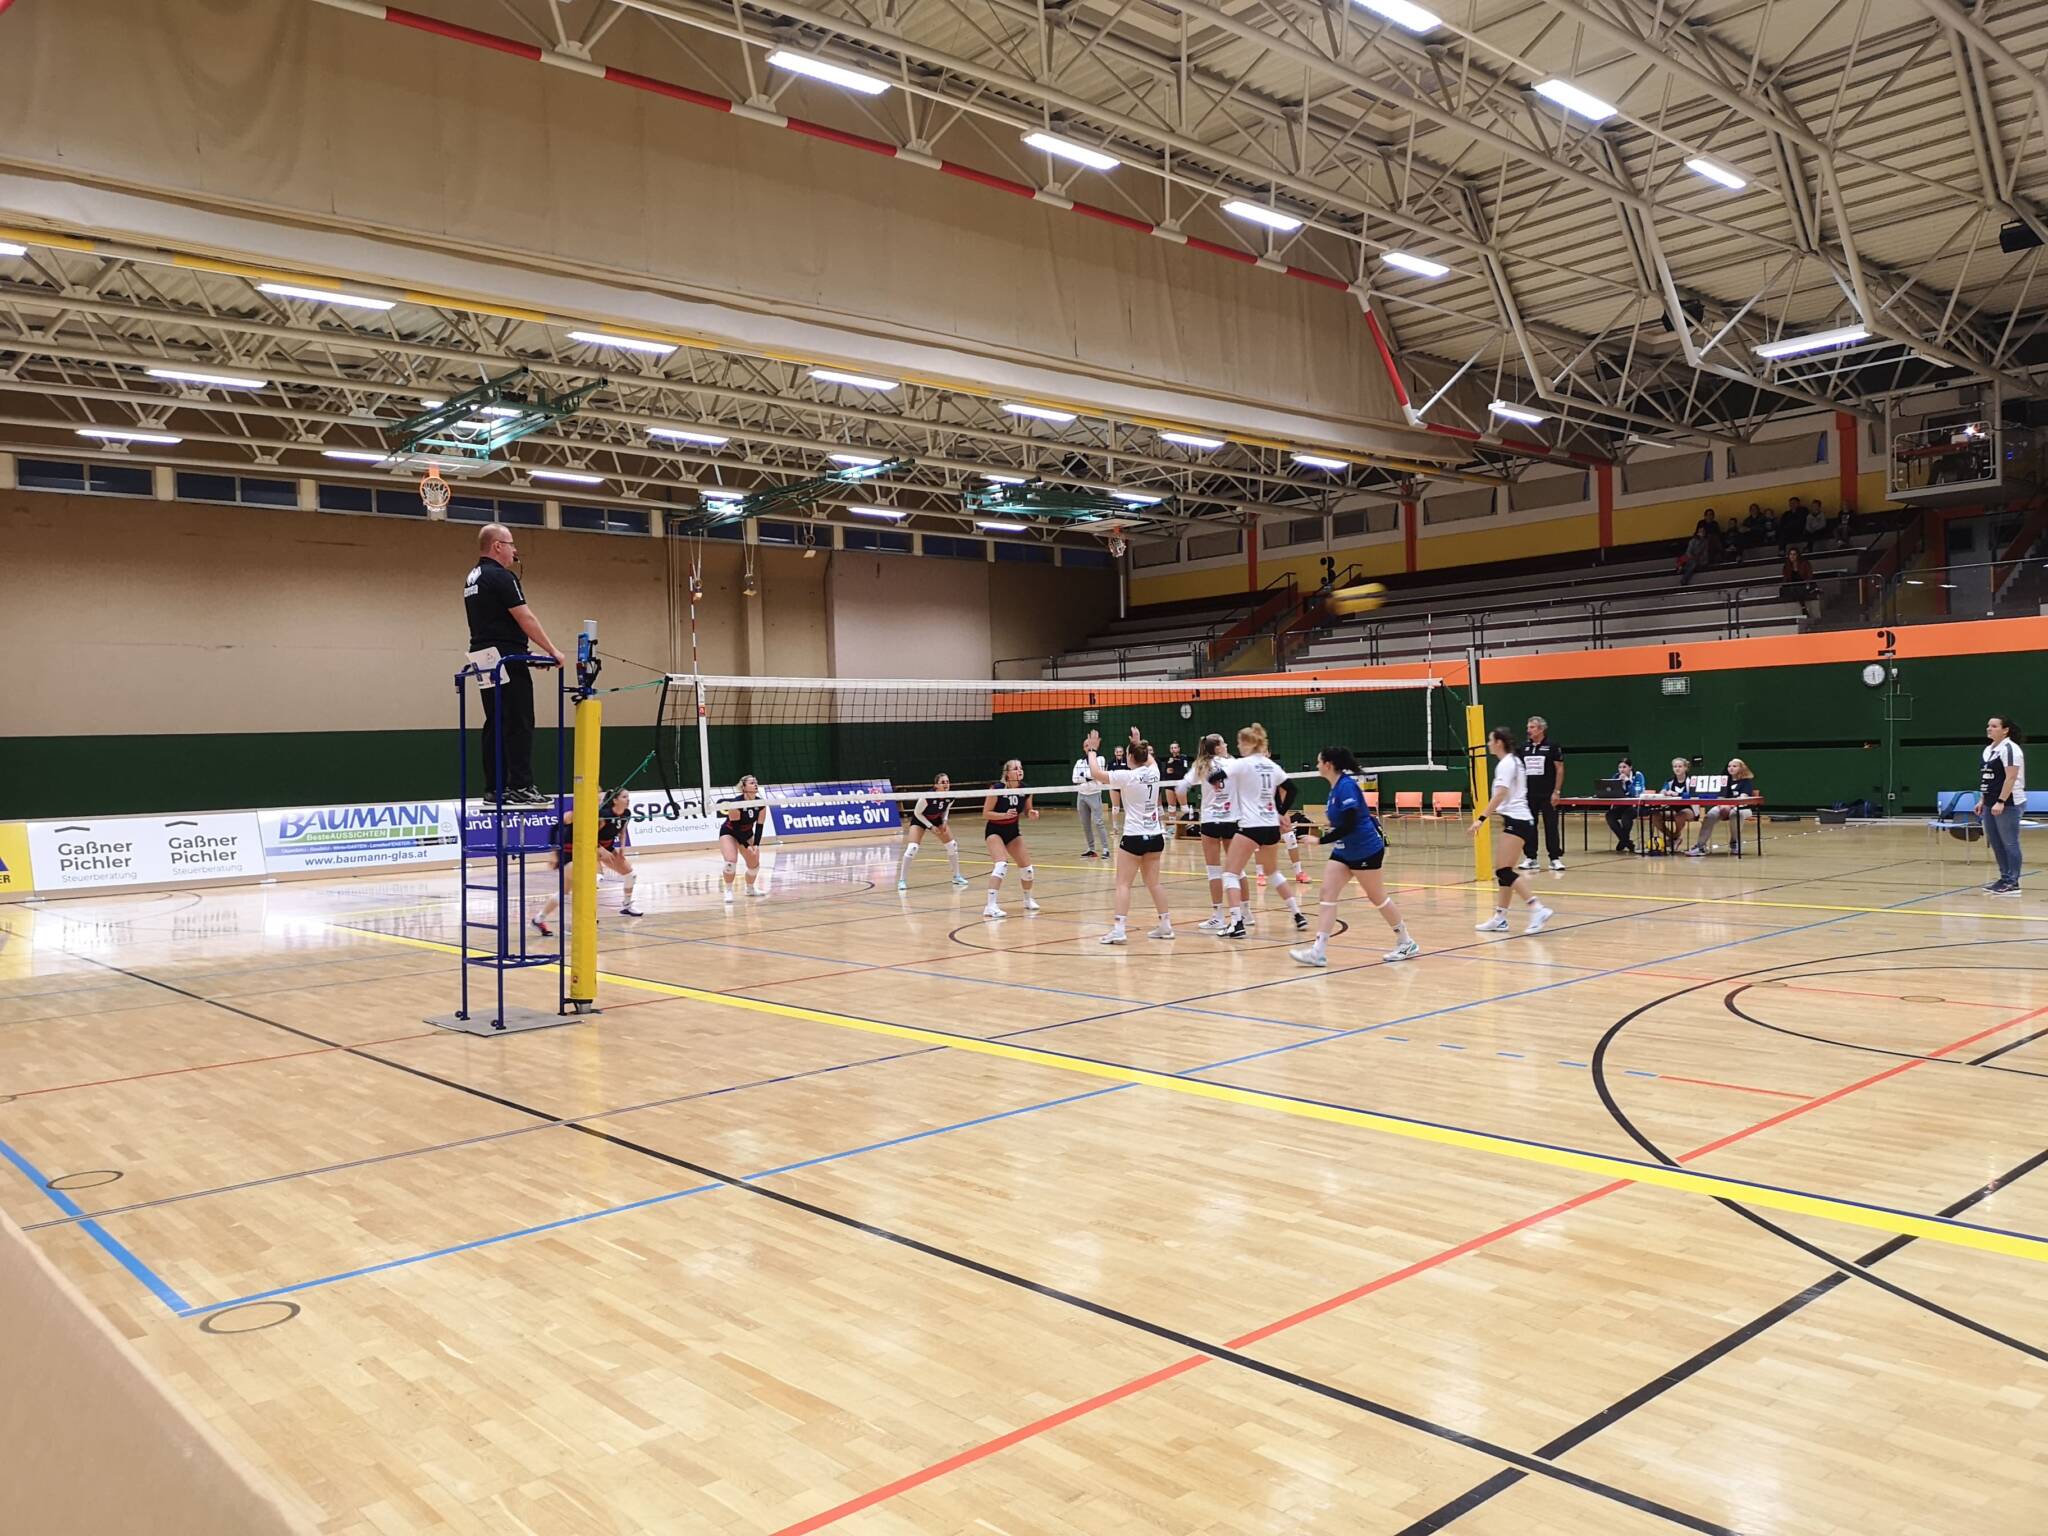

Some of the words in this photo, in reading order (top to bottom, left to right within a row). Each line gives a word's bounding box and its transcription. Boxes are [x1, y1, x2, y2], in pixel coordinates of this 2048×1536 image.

[1320, 556, 1336, 585] 3
[1669, 652, 1682, 669] B
[1261, 774, 1272, 788] 11
[1147, 784, 1153, 799] 7
[1008, 795, 1018, 806] 10
[748, 809, 754, 818] 9
[783, 814, 835, 829] Partner
[838, 810, 861, 826] des
[863, 805, 889, 823] ÖVV
[279, 804, 439, 839] BAUMANN
[58, 841, 132, 855] Gaßner
[168, 835, 237, 849] Gaßner
[60, 856, 132, 871] Pichler
[171, 850, 237, 864] Pichler
[305, 850, 427, 866] www.baumann-glas.at
[173, 864, 243, 875] Steuerberatung
[62, 871, 137, 883] Steuerberatung
